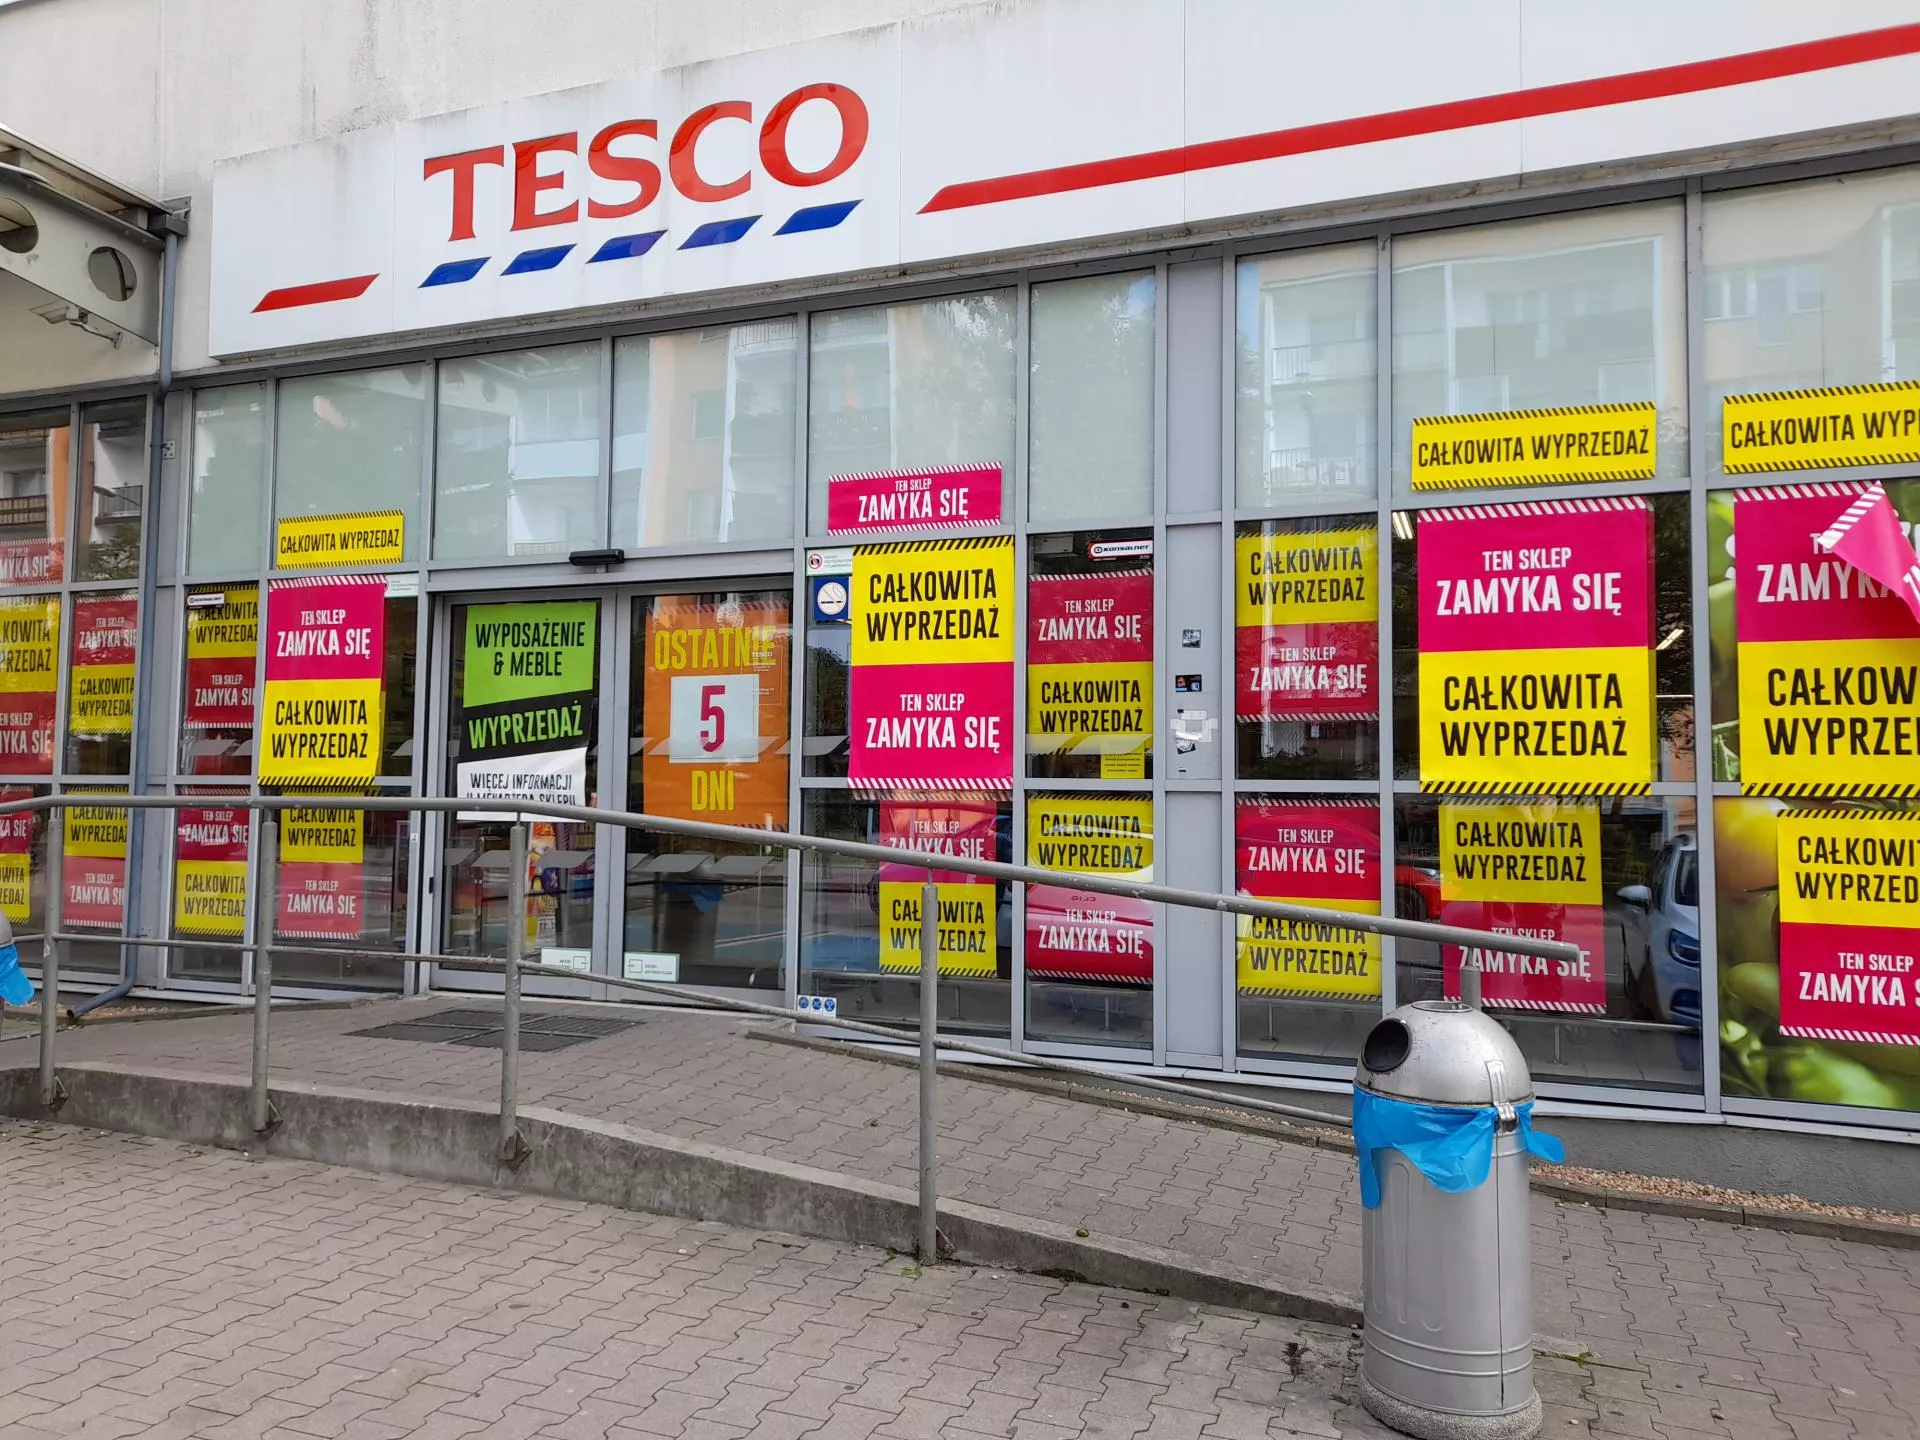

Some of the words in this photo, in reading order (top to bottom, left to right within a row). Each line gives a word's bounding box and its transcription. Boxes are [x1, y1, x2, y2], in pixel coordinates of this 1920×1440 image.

[424, 82, 869, 241] TESCO
[1731, 414, 1855, 449] CAŁKOWITA
[1862, 409, 1920, 439] WYP
[1418, 437, 1525, 468] CAŁKOWITA
[1531, 426, 1650, 461] WYPRZEDAŻ
[895, 479, 908, 492] TEN
[910, 478, 932, 491] SKLEP
[858, 491, 933, 522] ZAMYKA
[940, 487, 969, 520] SIĘ
[280, 532, 336, 554] CAŁKOWITA
[340, 528, 400, 550] WYPRZEDAŻ
[1250, 546, 1363, 576] CAŁKOWITA
[1482, 549, 1514, 570] TEN
[1519, 547, 1572, 568] SKLEP
[869, 568, 997, 604] CAŁKOWITA
[1248, 575, 1366, 606] WYPRZEDAŻ
[1436, 574, 1562, 616] ZAMYKA
[1573, 572, 1622, 616] SIĘ
[301, 610, 315, 626] TEN
[316, 609, 346, 625] SKLEP
[1064, 600, 1081, 614] TEN
[1084, 599, 1114, 613] SKLEP
[0, 619, 50, 643] KOWITA
[96, 617, 106, 627] TEN
[107, 616, 125, 627] SKLEP
[475, 619, 585, 649] WYPOSAŻENIE
[866, 604, 999, 642] WYPRZEDAŻ
[1038, 616, 1108, 641] ZAMYKA
[1114, 615, 1142, 642] SIĘ
[79, 630, 120, 649] ZAMYKA
[276, 629, 339, 657] ZAMYKA
[345, 628, 371, 660] SIĘ
[655, 626, 776, 670] OSTATNIE
[493, 652, 504, 676] &
[510, 651, 562, 676] MEBLE
[1280, 647, 1300, 662] TEN
[1303, 646, 1336, 661] SKLEP
[212, 674, 223, 686] TEN
[223, 674, 243, 685] SKLEP
[1250, 665, 1330, 691] ZAMYKA
[1336, 664, 1367, 693] SIĘ
[1768, 666, 1918, 706] CAŁKOW
[195, 687, 238, 706] ZAMYKA
[900, 694, 923, 711] TEN
[926, 693, 965, 711] SKLEP
[1041, 680, 1141, 704] CAŁKOWITA
[1443, 673, 1623, 711] CAŁKOWITA
[10, 711, 33, 726] SKLEP
[78, 698, 133, 718] WYPRZEDA
[275, 700, 367, 726] CAŁKOWITA
[700, 685, 725, 753] 5
[1039, 706, 1143, 732] WYPRZEDAŻ
[468, 700, 583, 749] WYPRZEDAŻ
[865, 717, 956, 749] ZAMYKA
[964, 716, 999, 753] SIĘ
[1440, 716, 1628, 757] WYPRZEDAŻ
[0, 730, 28, 754] YKA
[272, 730, 368, 758] WYPRZEDAŻ
[471, 773, 509, 791] WIĘCEJ
[513, 773, 572, 790] INFORMACJI
[691, 770, 734, 811] DNI
[13, 819, 27, 839] SIĘ
[203, 811, 215, 822] TEN
[216, 811, 233, 822] SKLEP
[290, 808, 355, 824] CAŁKOWITA
[914, 820, 930, 833] TEN
[933, 820, 960, 833] SKLEP
[1040, 813, 1142, 839] CAŁKOWITA
[184, 823, 229, 844] ZAMYKA
[232, 825, 248, 847] SIĘ
[288, 826, 356, 848] WYPRZEDAŻ
[1277, 828, 1297, 843] TEN
[1300, 828, 1334, 844] SKLEP
[1456, 821, 1584, 849] CAŁKOWITA
[1038, 842, 1143, 868] WYPRZEDAŻ
[1248, 846, 1327, 873] ZAMYKA
[1335, 848, 1365, 879] SIĘ
[1798, 836, 1920, 867] CAŁKOWI
[86, 873, 97, 884] TEN
[97, 874, 114, 885] SKLEP
[1454, 853, 1587, 882] WYPRZEDAŻ
[70, 885, 109, 905] ZAMYKA
[186, 874, 246, 894] CAŁKOWITA
[305, 880, 318, 891] TEN
[318, 881, 339, 892] SKLEP
[1795, 872, 1919, 903] WYPRZED
[287, 894, 333, 914] ZAMYKA
[337, 895, 356, 918] SIĘ
[893, 899, 985, 924] CAŁWITA
[1065, 908, 1083, 922] TEN
[1086, 909, 1117, 924] SKLEP
[890, 927, 987, 953] WYZEDAŻ
[1038, 925, 1110, 953] ZAMYKA
[1116, 929, 1144, 959] SIĘ
[1252, 914, 1366, 944] CAŁKOWITA
[1250, 946, 1368, 976] WYPRZEDAŻ
[1838, 952, 1864, 970] TEN
[1869, 954, 1914, 972] SKLEP
[1799, 972, 1906, 1007] ZAMYKA
